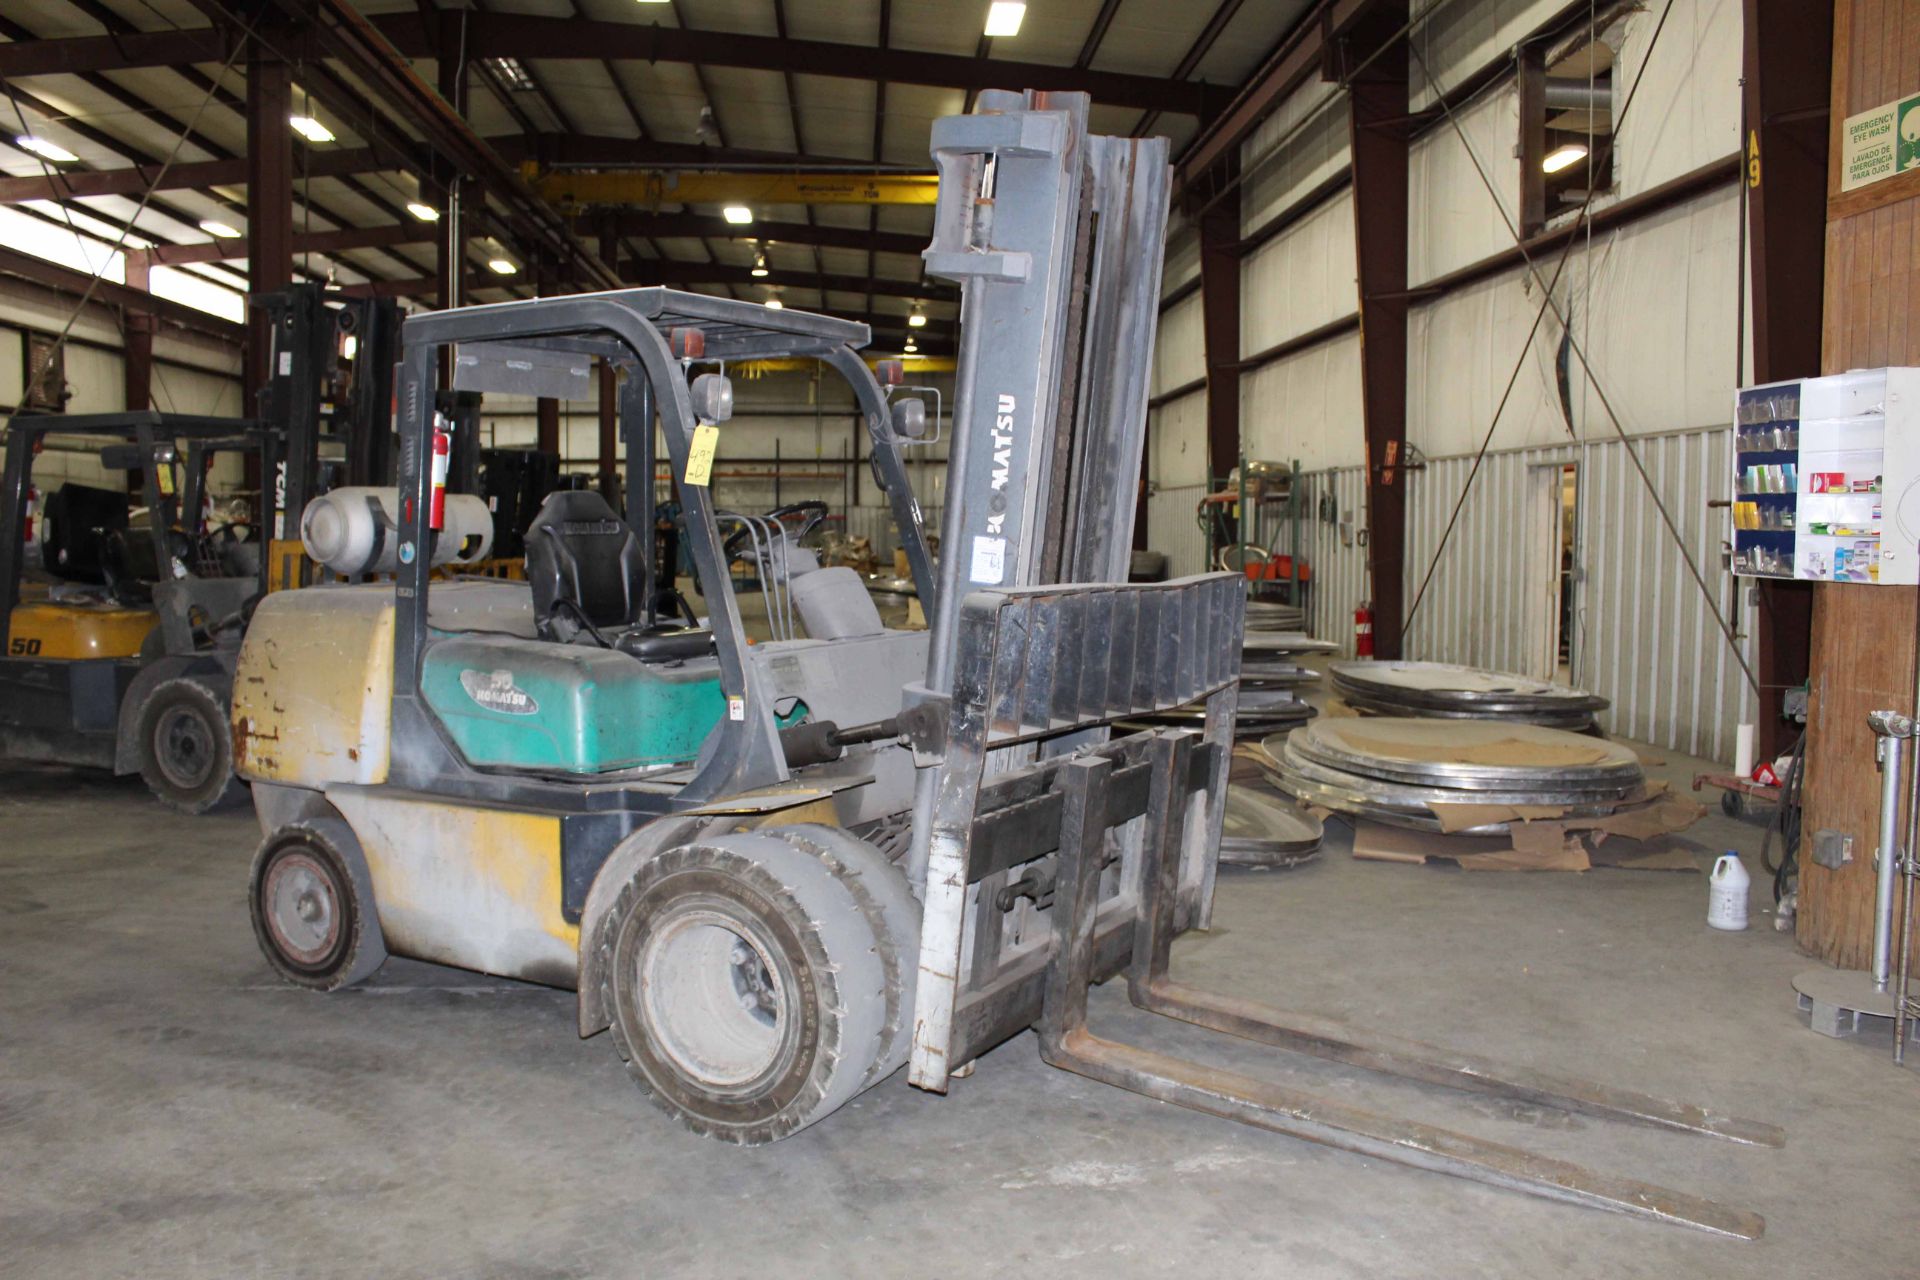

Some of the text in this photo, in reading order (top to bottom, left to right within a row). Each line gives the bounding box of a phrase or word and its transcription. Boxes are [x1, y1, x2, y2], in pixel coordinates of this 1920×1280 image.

[1850, 112, 1894, 135] EMERGENCY
[1853, 124, 1891, 144] EYE WASH
[1849, 154, 1893, 174] EMERGENCIA
[1853, 145, 1891, 164] LAVADO DE
[1852, 163, 1890, 181] PARA OJOS
[275, 460, 287, 509] TCM
[12, 637, 41, 655] 50
[476, 689, 527, 706] KOMATSU
